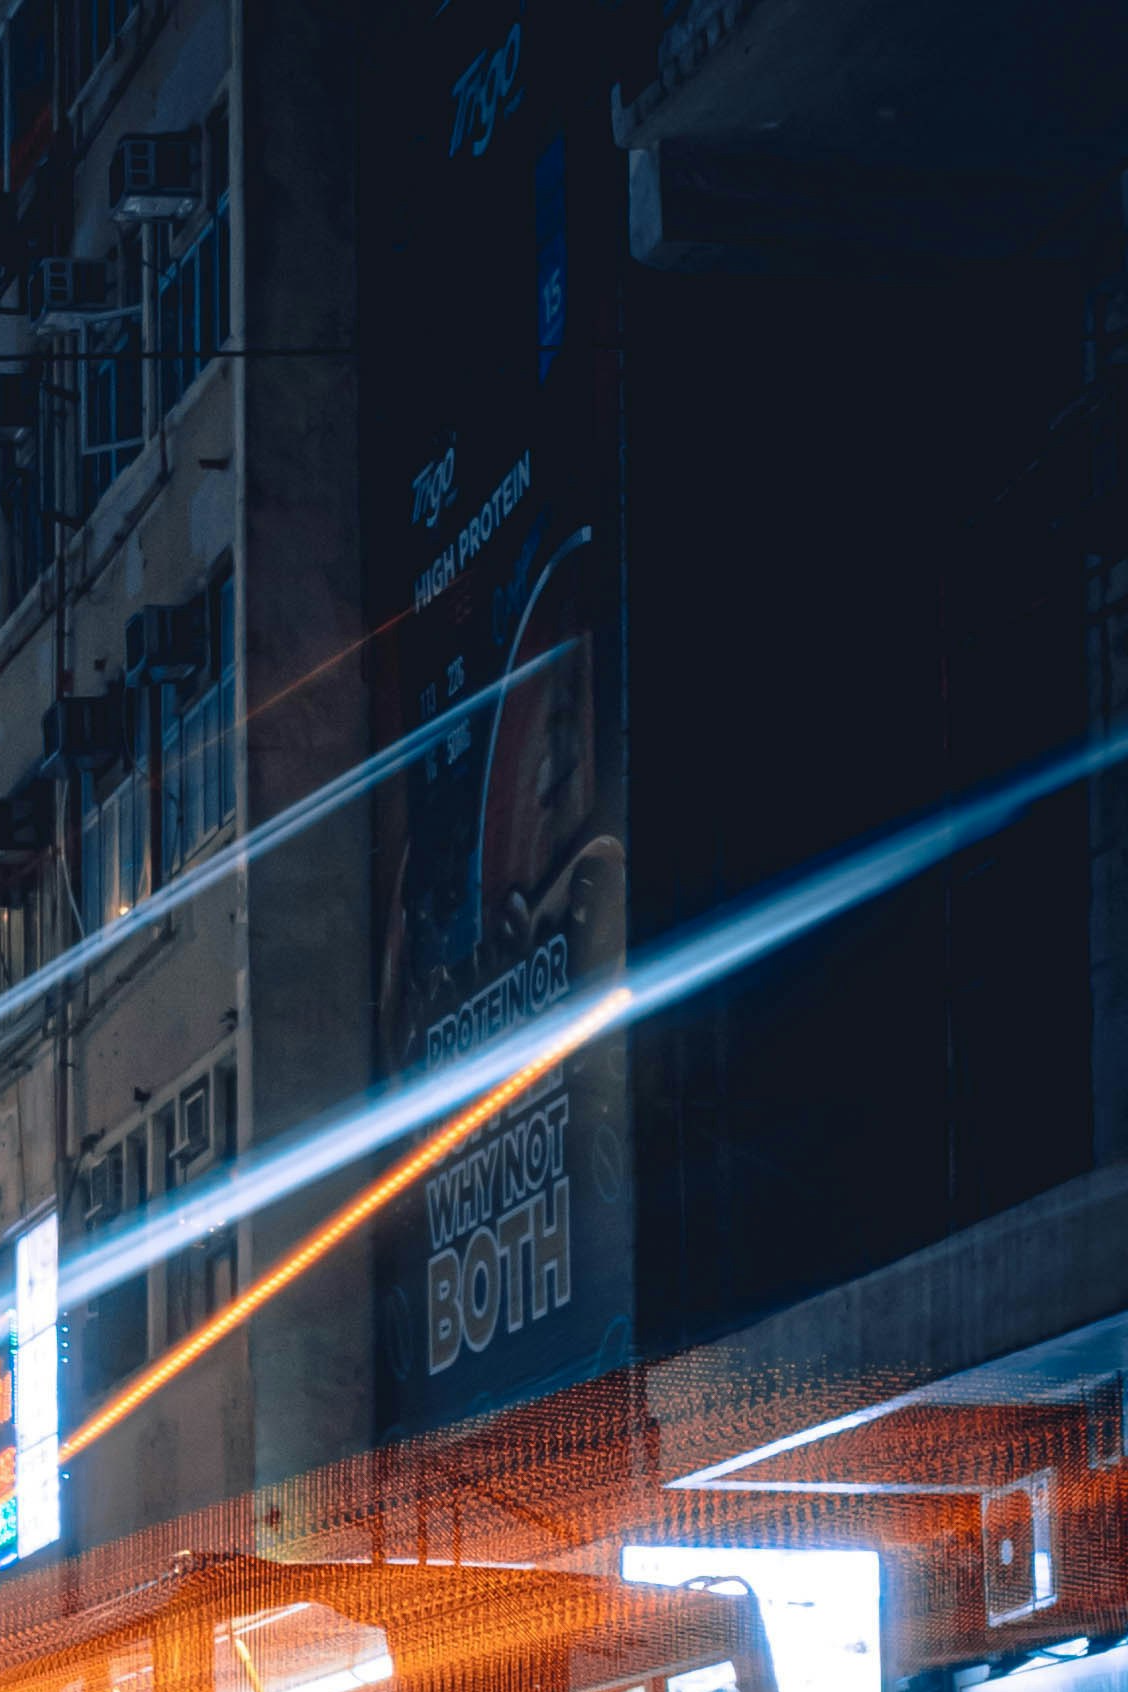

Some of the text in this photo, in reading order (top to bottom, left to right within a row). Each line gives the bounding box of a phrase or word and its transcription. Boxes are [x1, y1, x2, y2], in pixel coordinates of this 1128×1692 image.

[414, 543, 456, 614] HIGH
[458, 448, 531, 571] PROTEIN
[427, 933, 569, 1068] PROTEIN OR
[425, 1139, 500, 1250] WHY
[501, 1092, 570, 1202] NOT
[427, 1176, 571, 1376] BOTH
